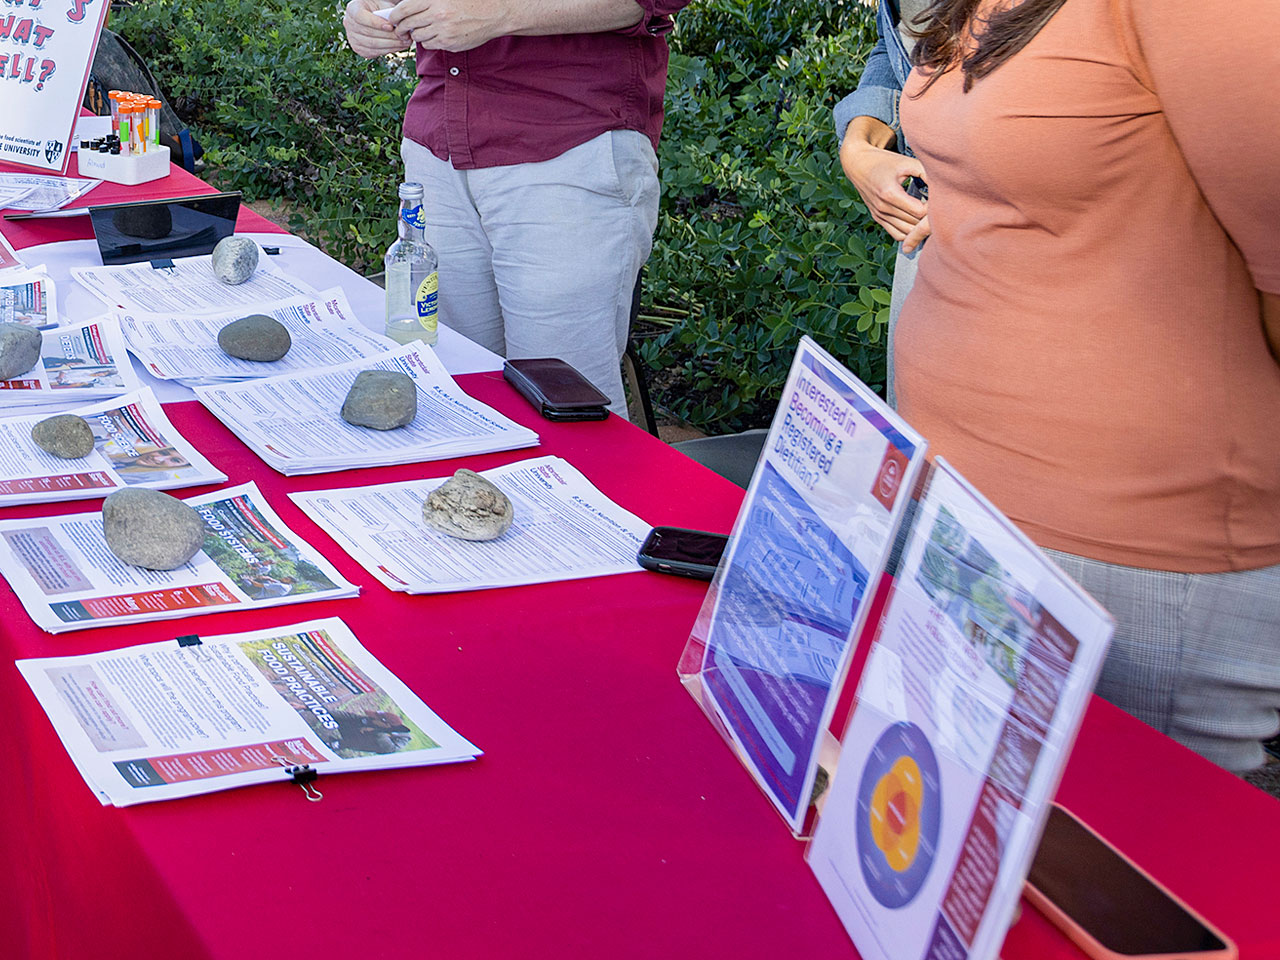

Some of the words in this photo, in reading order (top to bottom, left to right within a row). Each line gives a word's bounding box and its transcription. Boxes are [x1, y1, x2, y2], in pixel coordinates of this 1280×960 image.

[3, 143, 41, 158] UNIVERSITY
[4, 134, 14, 142] food
[15, 136, 35, 146] scientists
[405, 354, 417, 368] State
[411, 351, 430, 375] Montclair
[787, 390, 836, 452] Becoming
[795, 367, 848, 429] Interested
[843, 411, 858, 440] in
[96, 415, 119, 432] FOOD
[110, 432, 140, 457] SCIENCE
[780, 411, 834, 480] Registered
[773, 432, 820, 495] Dietitian?
[196, 509, 227, 530] FOOD
[217, 529, 260, 563] SYSTEMS
[135, 653, 153, 665] What
[142, 664, 166, 682] topics
[204, 644, 237, 671] Sustainable
[228, 671, 248, 685] Food
[239, 685, 269, 709] Practices?
[214, 642, 233, 654] Why
[228, 658, 257, 681] certificate
[267, 641, 339, 703] SUSTAINABLE
[164, 691, 180, 700] the
[170, 649, 188, 660] Who
[186, 668, 209, 686] benefit
[200, 686, 219, 699] from
[216, 707, 247, 733] program?
[253, 648, 291, 675] FOOD
[278, 675, 343, 730] PRACTICES
[170, 700, 195, 720] program
[188, 720, 212, 739] cover?
